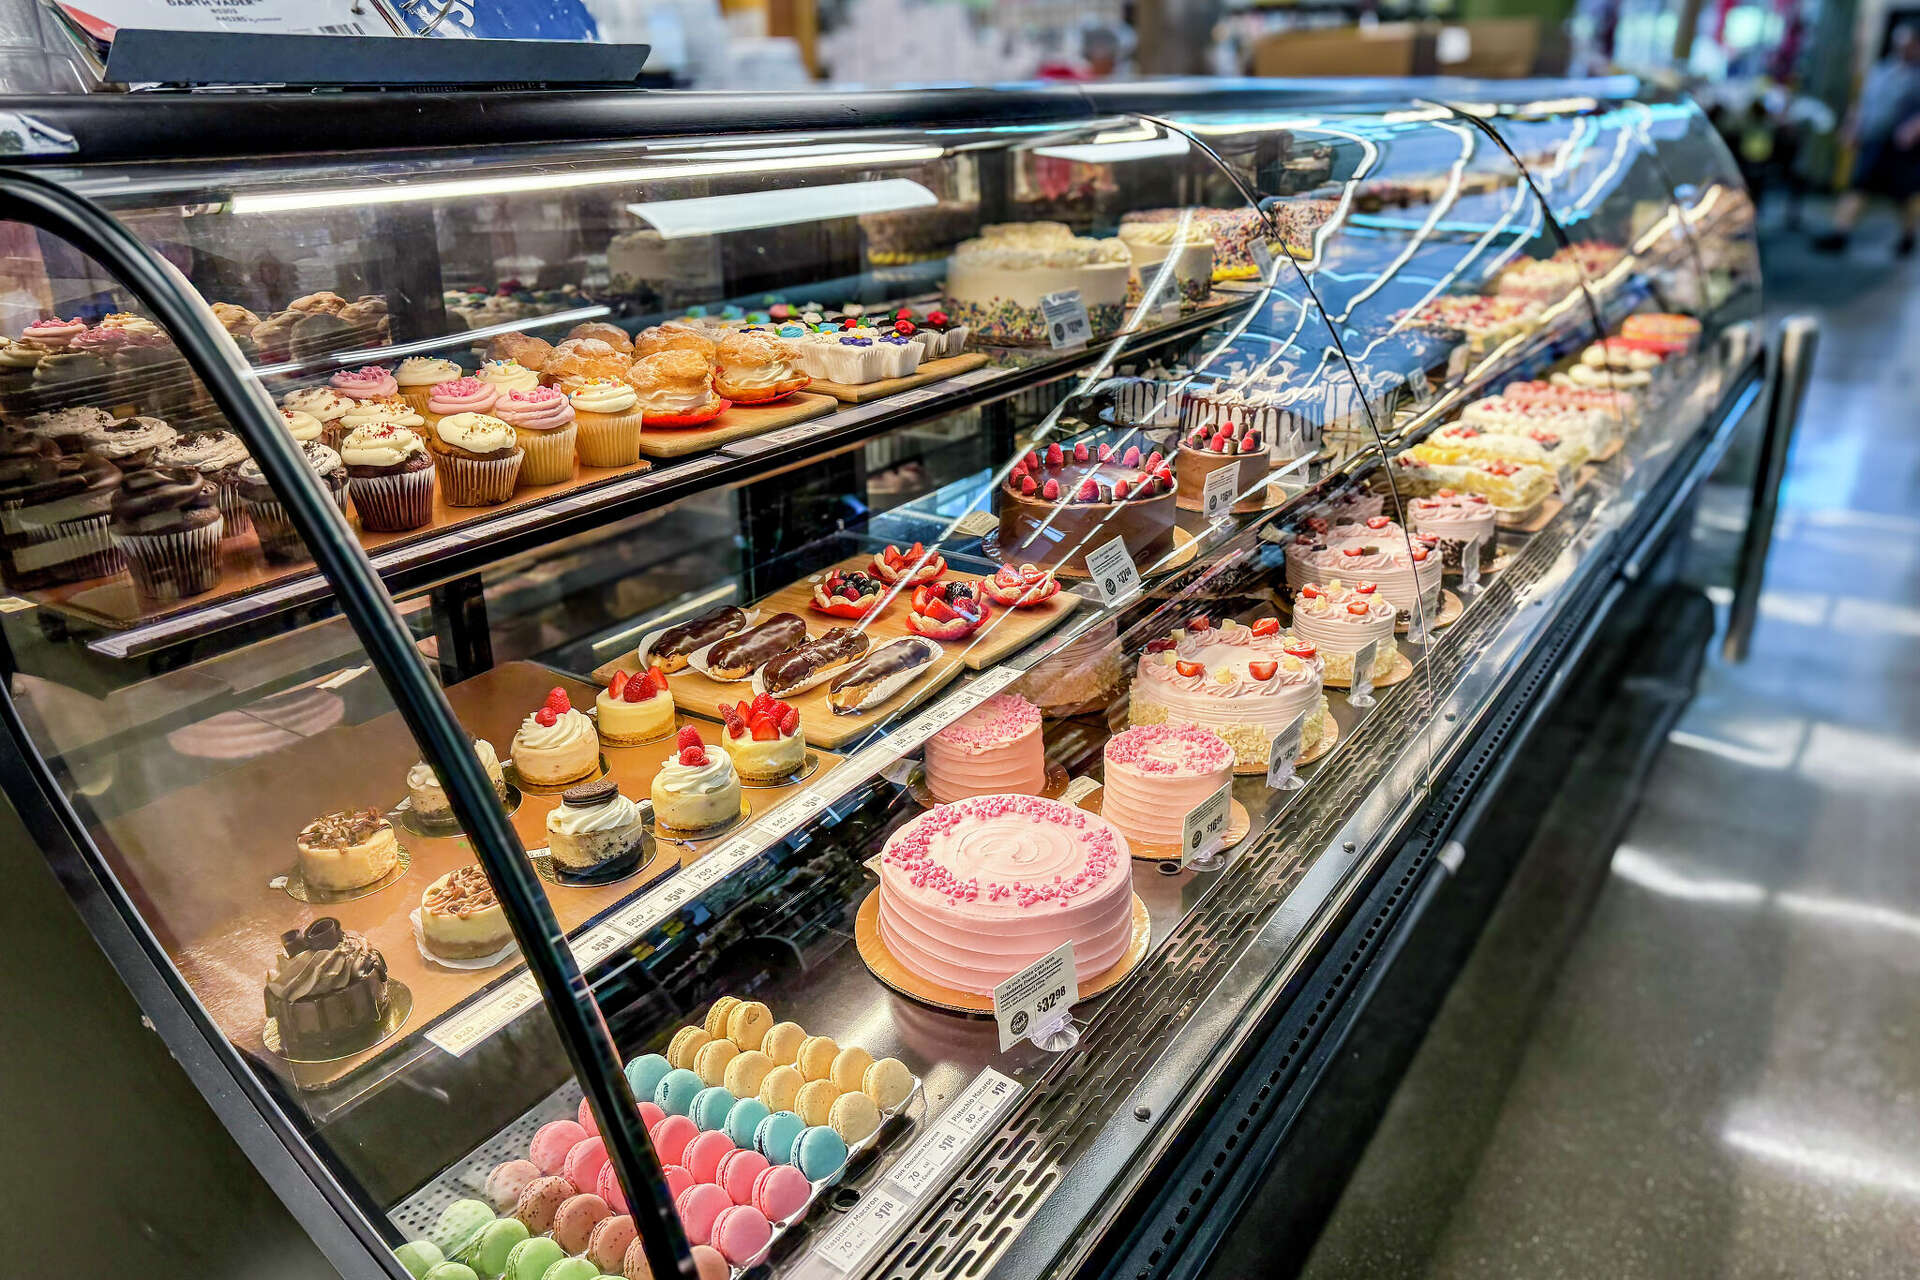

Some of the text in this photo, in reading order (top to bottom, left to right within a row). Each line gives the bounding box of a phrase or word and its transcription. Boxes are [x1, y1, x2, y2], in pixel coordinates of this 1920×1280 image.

[991, 1081, 1007, 1096] $178
[951, 1098, 975, 1121] Pistachio
[965, 1113, 976, 1123] 80
[938, 1134, 956, 1151] $178
[894, 1169, 904, 1180] Dark
[923, 1131, 940, 1148] Macaron
[908, 1171, 920, 1182] 70
[874, 1201, 894, 1219] $178
[824, 1196, 879, 1250] Raspberry Macaron
[840, 1241, 853, 1253] 70
